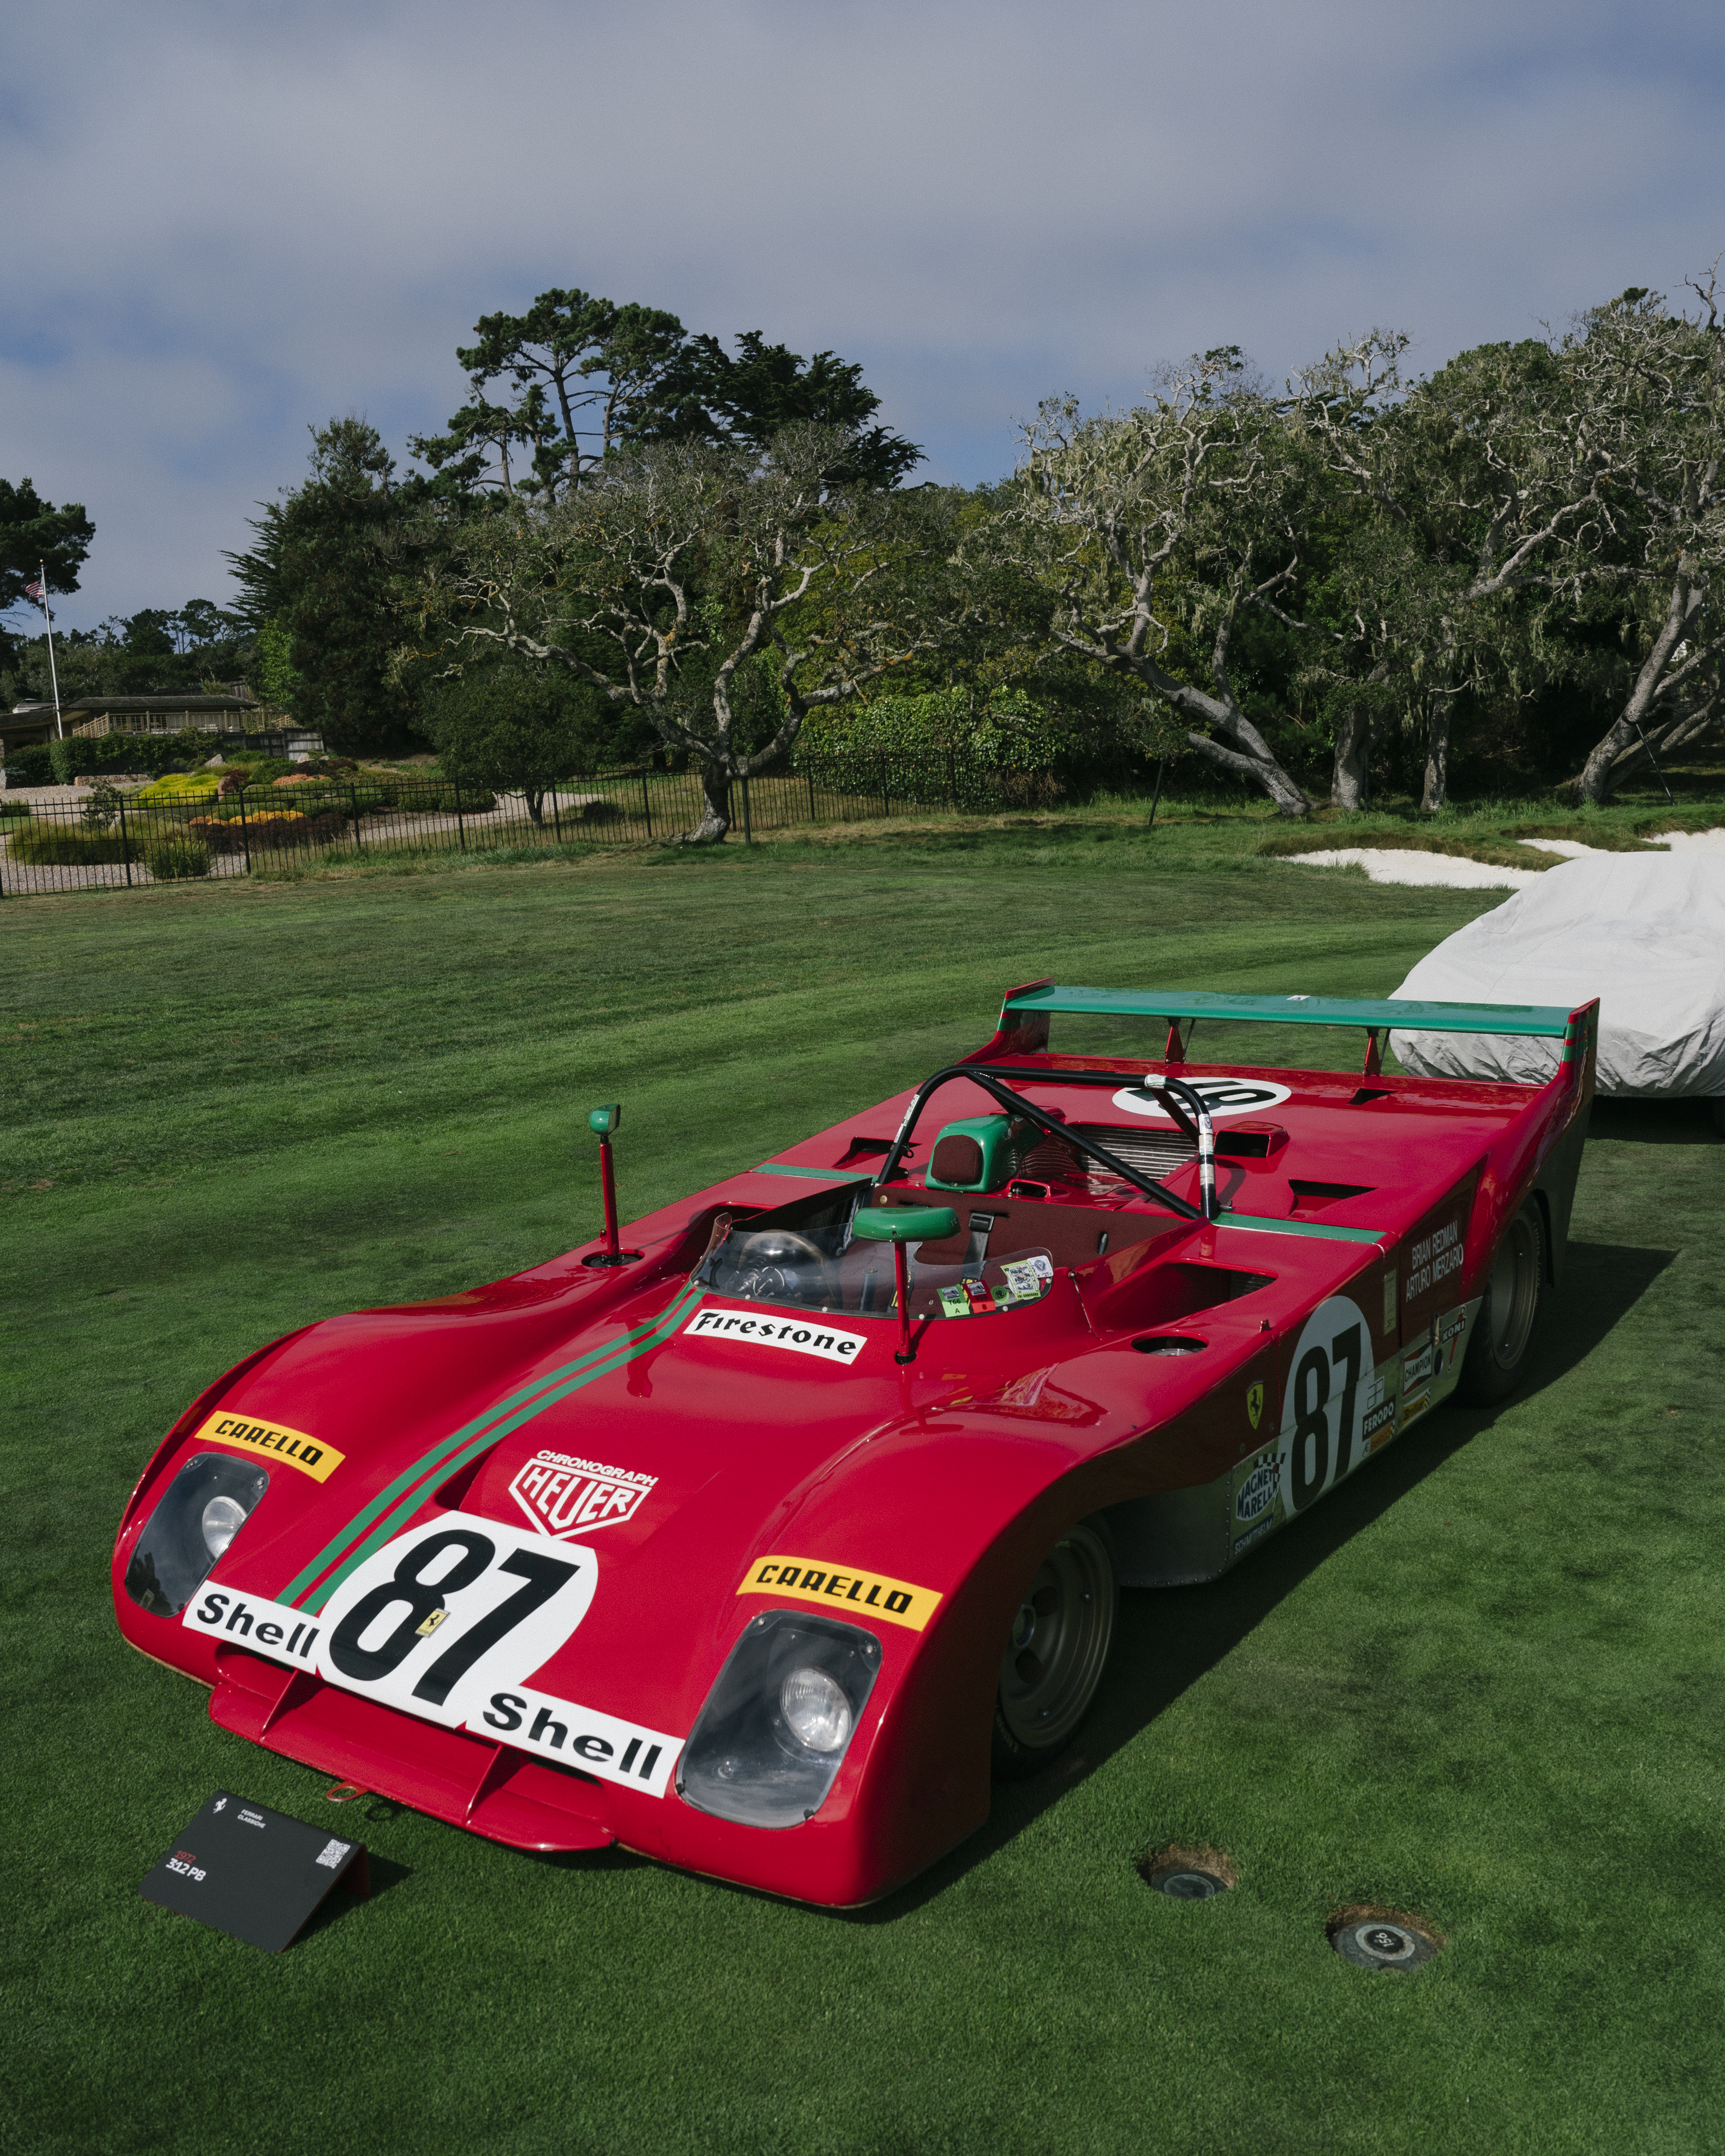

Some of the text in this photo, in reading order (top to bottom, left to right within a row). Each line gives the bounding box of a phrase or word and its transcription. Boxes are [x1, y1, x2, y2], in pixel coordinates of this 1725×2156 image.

[1412, 1220, 1457, 1270] BRIAN REDMAN
[1406, 1243, 1464, 1302] ARTURO MERZARIO
[693, 1313, 857, 1355] Firestone
[1442, 1320, 1465, 1342] KONI
[1404, 1353, 1431, 1383] CHAMPION
[1291, 1321, 1361, 1511] 87
[1364, 1401, 1394, 1435] FERODO
[215, 1420, 323, 1466] CARELLO
[537, 1450, 658, 1487] CHRONOGRAPH
[522, 1466, 635, 1529] HEUER
[756, 1565, 913, 1614] CARELLO
[196, 1593, 321, 1659] Shell
[329, 1529, 581, 1706] 87
[482, 1692, 663, 1780] Shell
[237, 1814, 266, 1829] CLASSICHE
[241, 1809, 263, 1820] FERRARI
[166, 1858, 206, 1882] 312 PB
[174, 1850, 196, 1864] 1972
[1375, 1932, 1394, 1947] 156
